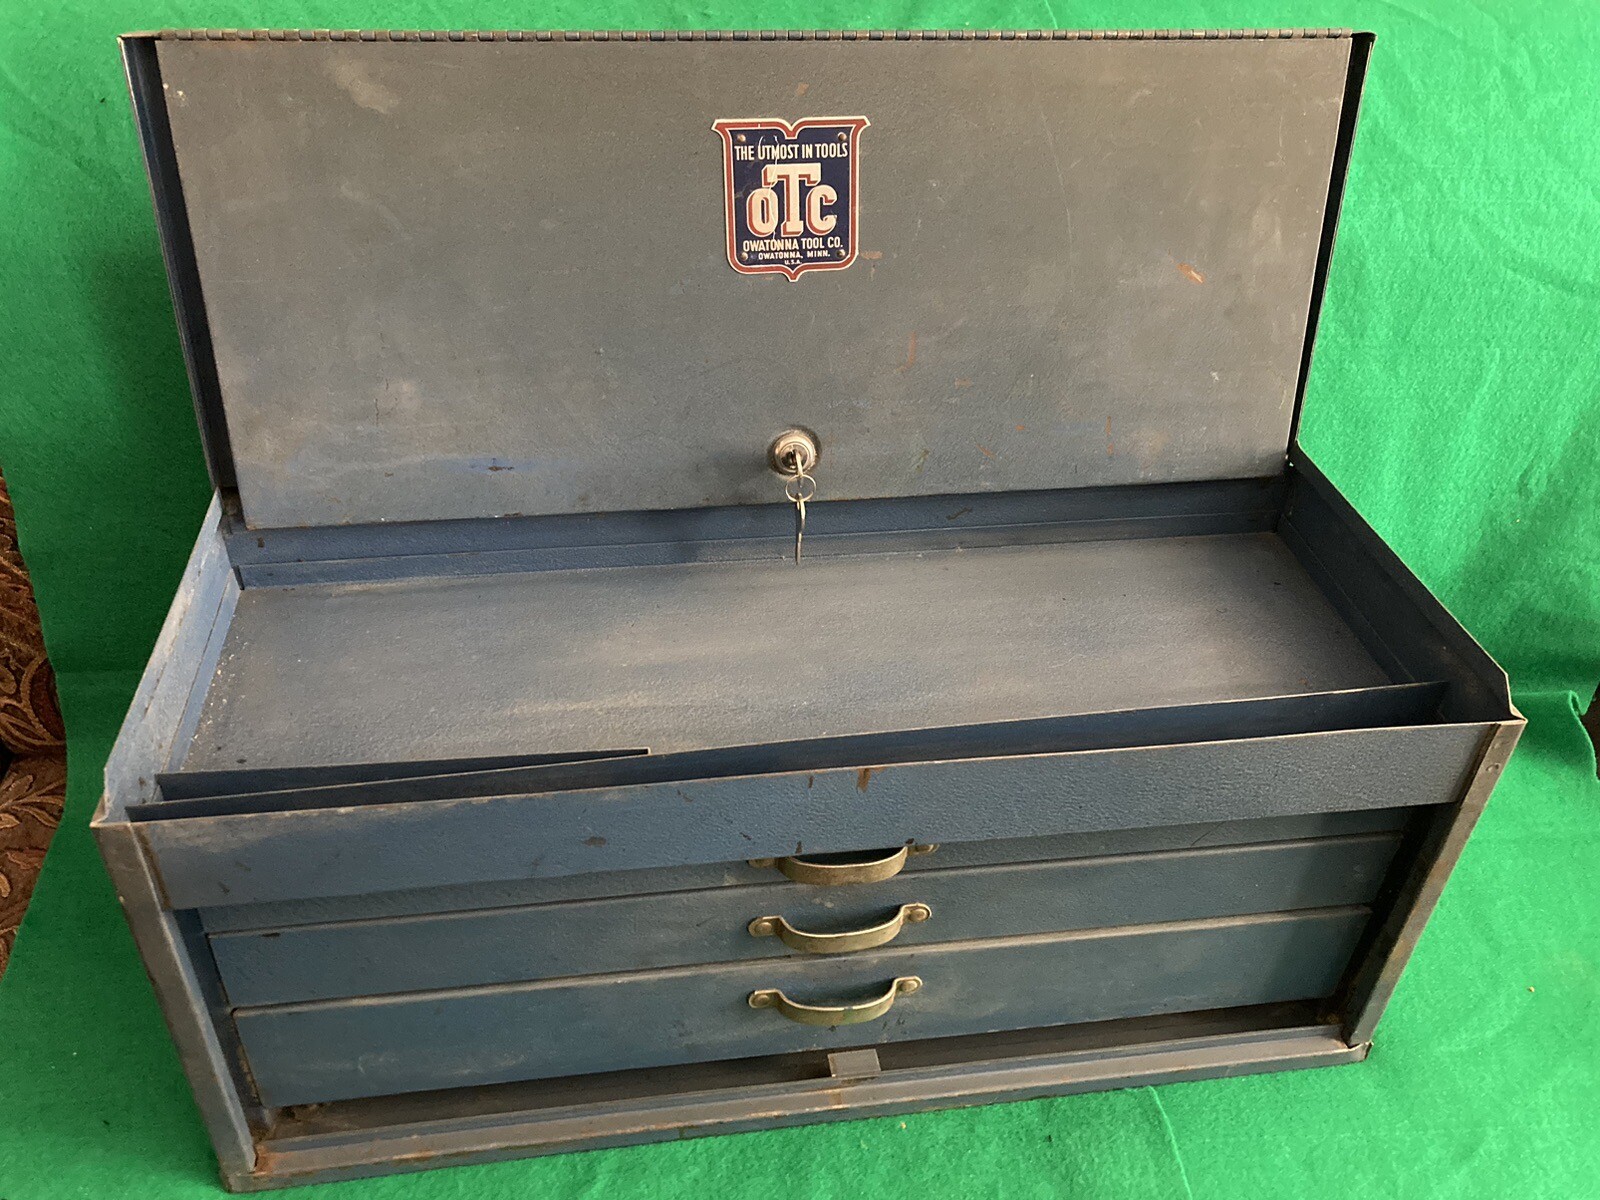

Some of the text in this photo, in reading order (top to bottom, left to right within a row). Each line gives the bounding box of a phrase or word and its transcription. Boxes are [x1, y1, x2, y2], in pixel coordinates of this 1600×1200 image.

[735, 142, 848, 161] THE UTMOST IN TOOLS
[743, 236, 843, 252] OWATONNA TOOL CO.
[807, 250, 831, 258] MINN.
